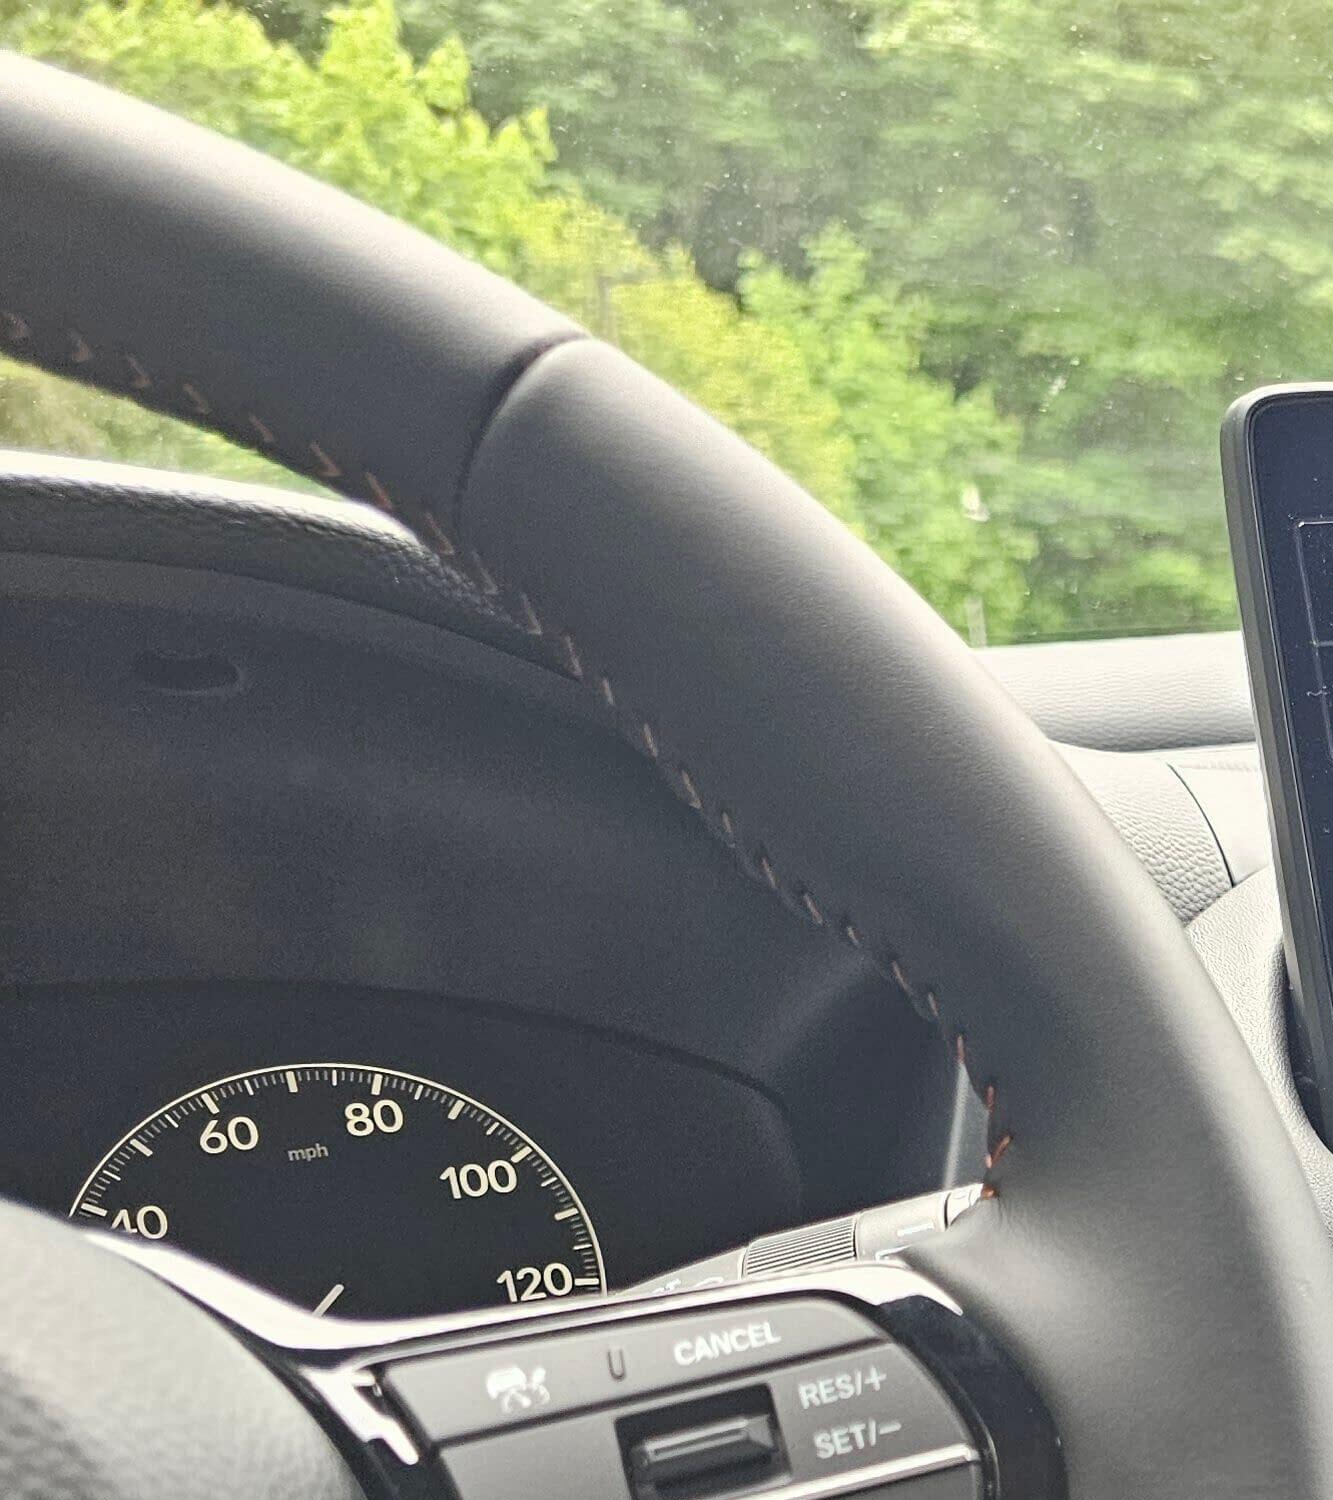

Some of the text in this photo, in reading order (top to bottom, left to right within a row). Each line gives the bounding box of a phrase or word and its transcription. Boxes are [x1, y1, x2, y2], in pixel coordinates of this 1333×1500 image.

[199, 1115, 260, 1155] 60
[344, 1098, 404, 1137] 80
[287, 1143, 330, 1163] mph
[438, 1159, 518, 1200] 100
[496, 1262, 574, 1304] 120
[673, 1320, 782, 1366] CANCEL
[799, 1366, 888, 1410] RES/+
